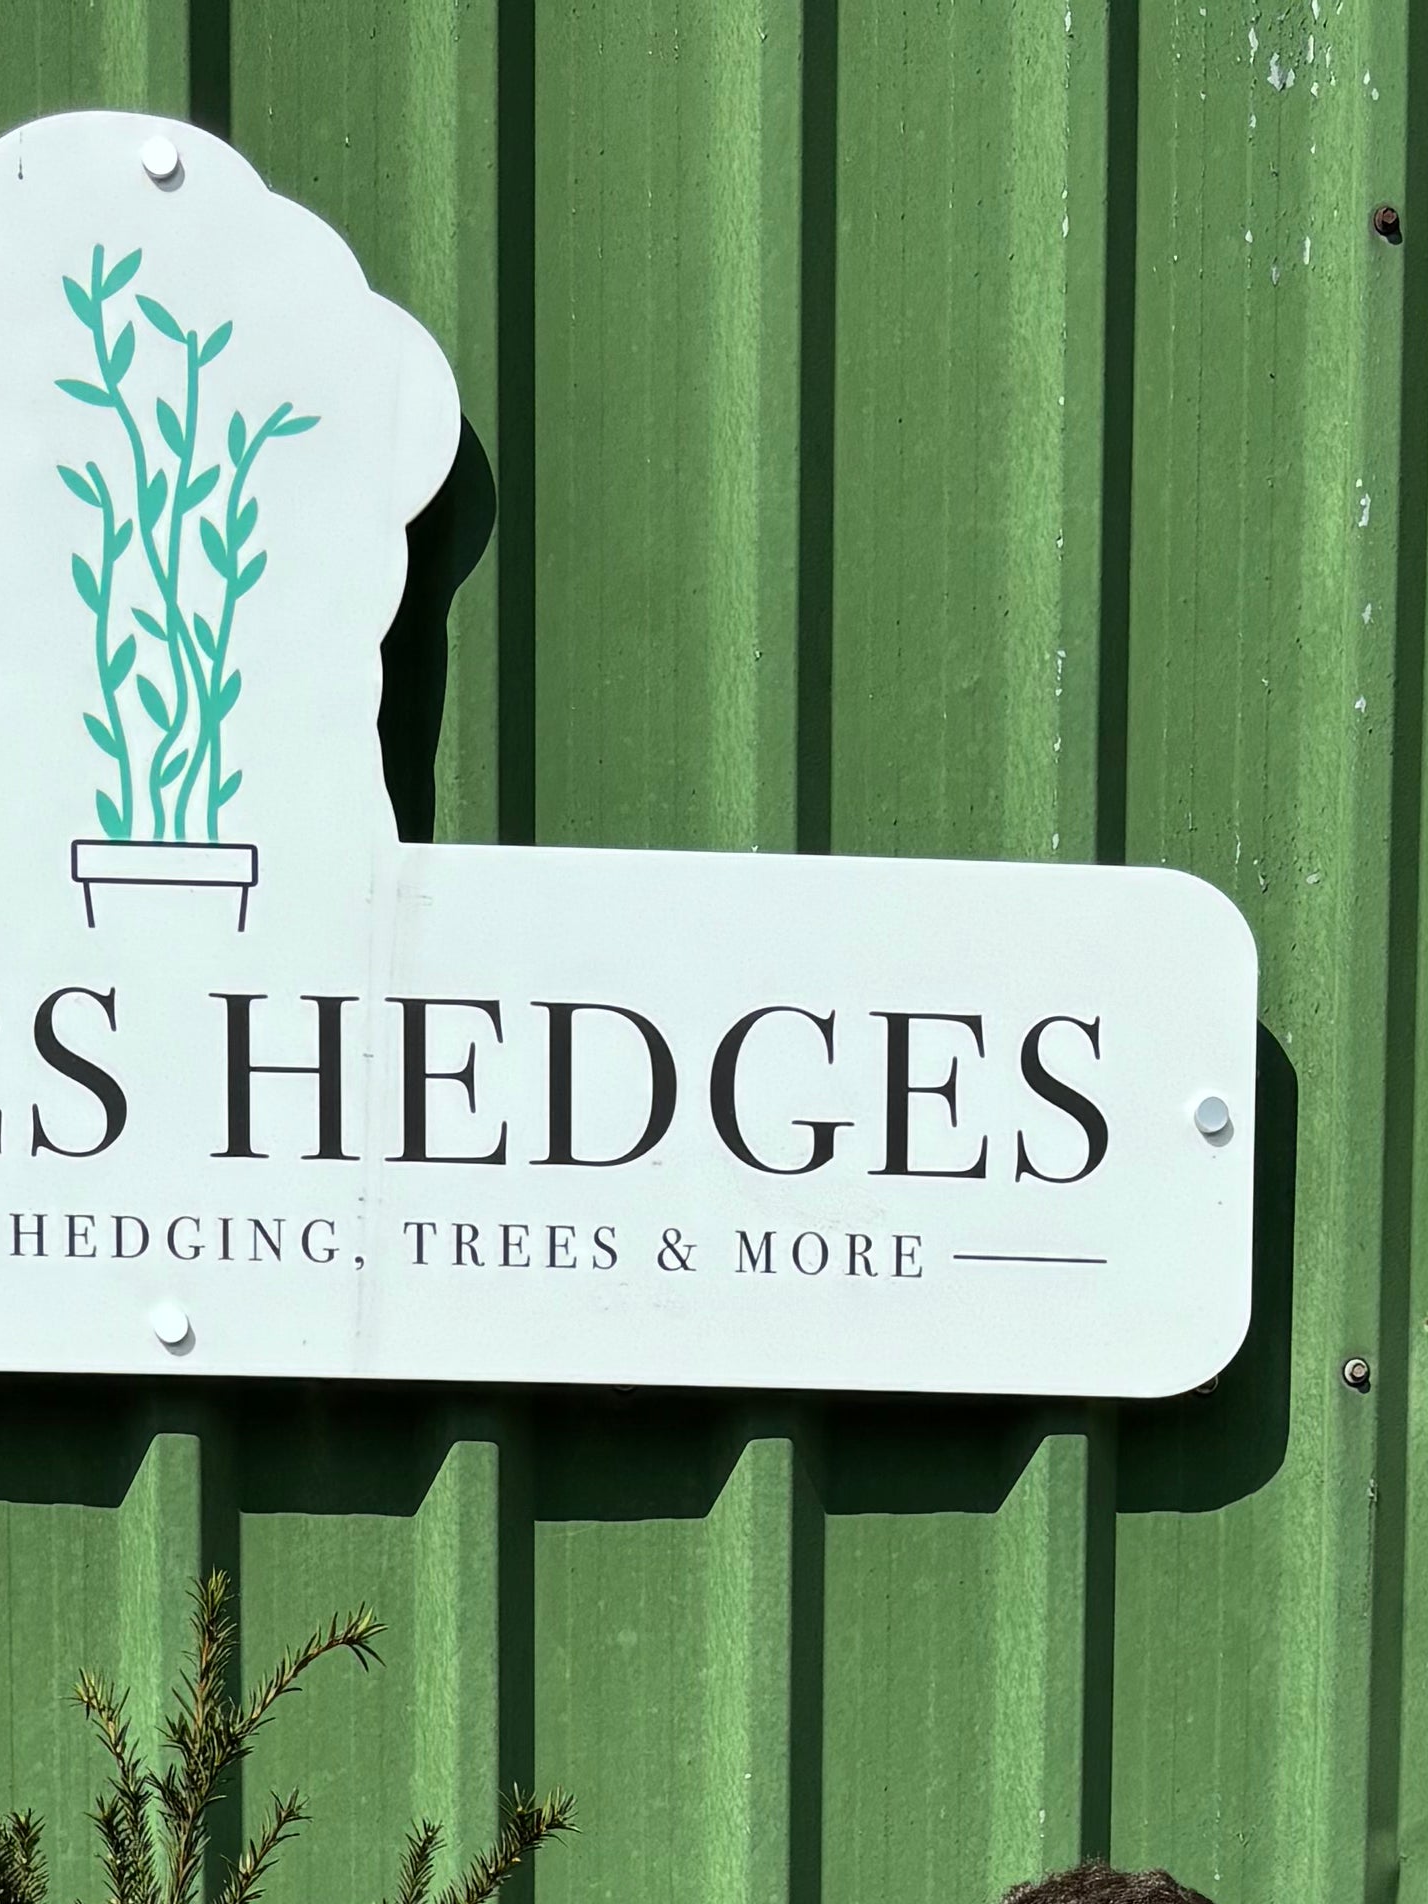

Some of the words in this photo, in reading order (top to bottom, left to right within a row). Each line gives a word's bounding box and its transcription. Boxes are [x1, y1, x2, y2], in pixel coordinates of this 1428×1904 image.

[209, 993, 1109, 1184] HEDGES
[9, 1213, 365, 1271] HEDGING,
[403, 1221, 618, 1270] TREES
[657, 1227, 696, 1272] &
[735, 1230, 923, 1278] MORE
